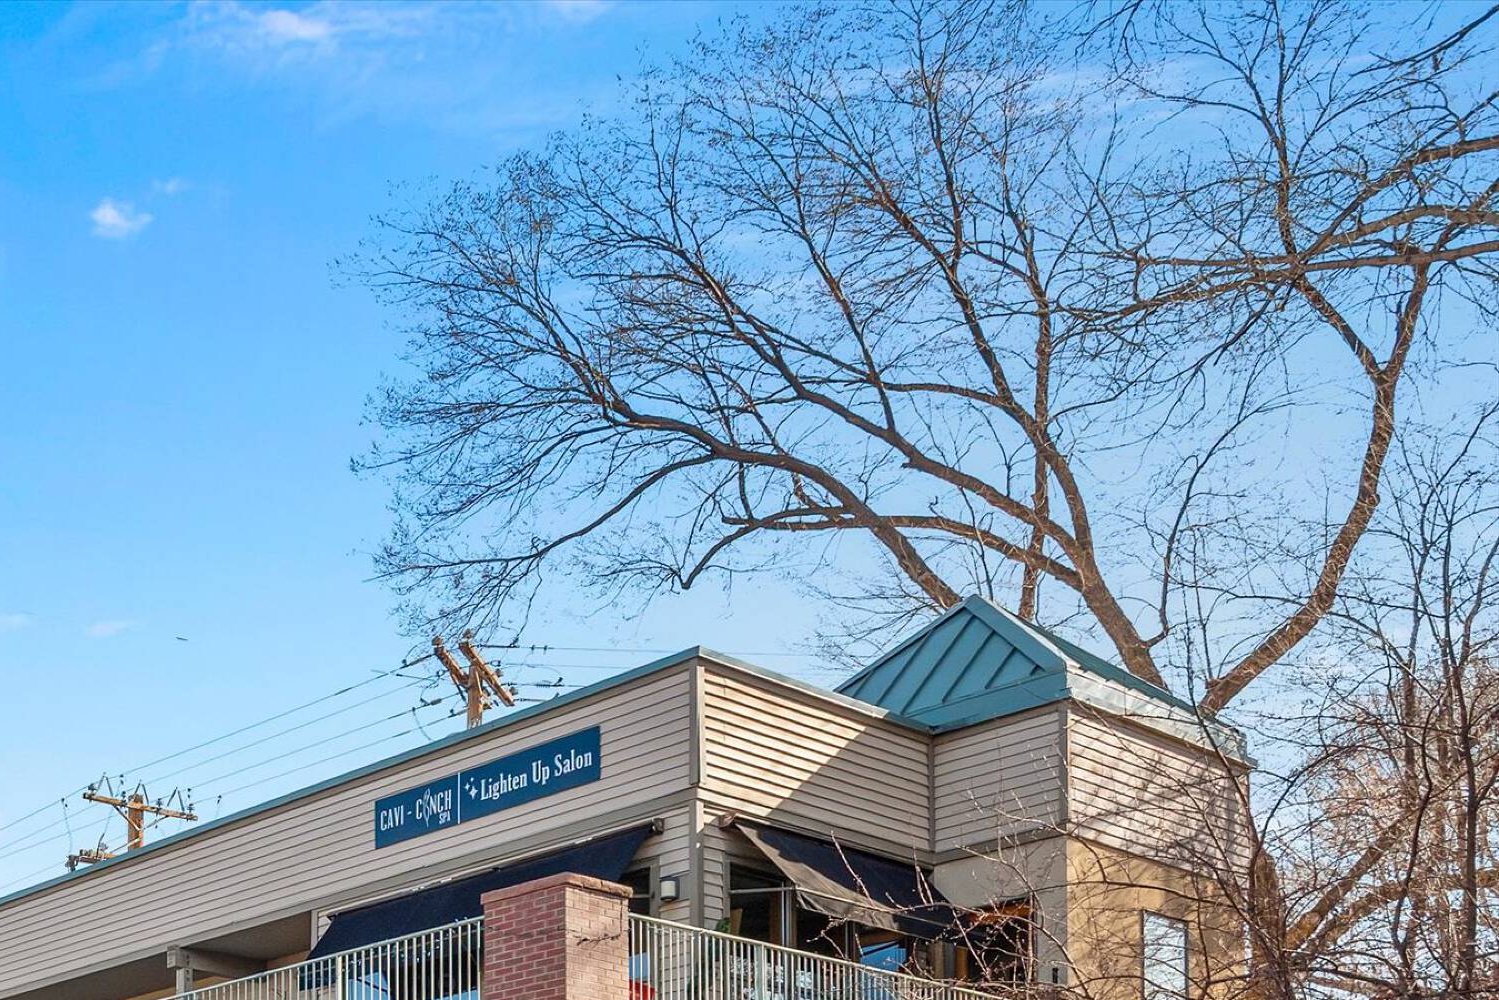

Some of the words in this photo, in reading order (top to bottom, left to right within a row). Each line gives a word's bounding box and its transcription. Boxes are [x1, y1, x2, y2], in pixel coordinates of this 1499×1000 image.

[480, 773, 528, 801] Lighten
[531, 760, 550, 786] Up
[554, 749, 593, 777] Salon
[380, 805, 404, 831] CAVI
[439, 810, 451, 825] SPA
